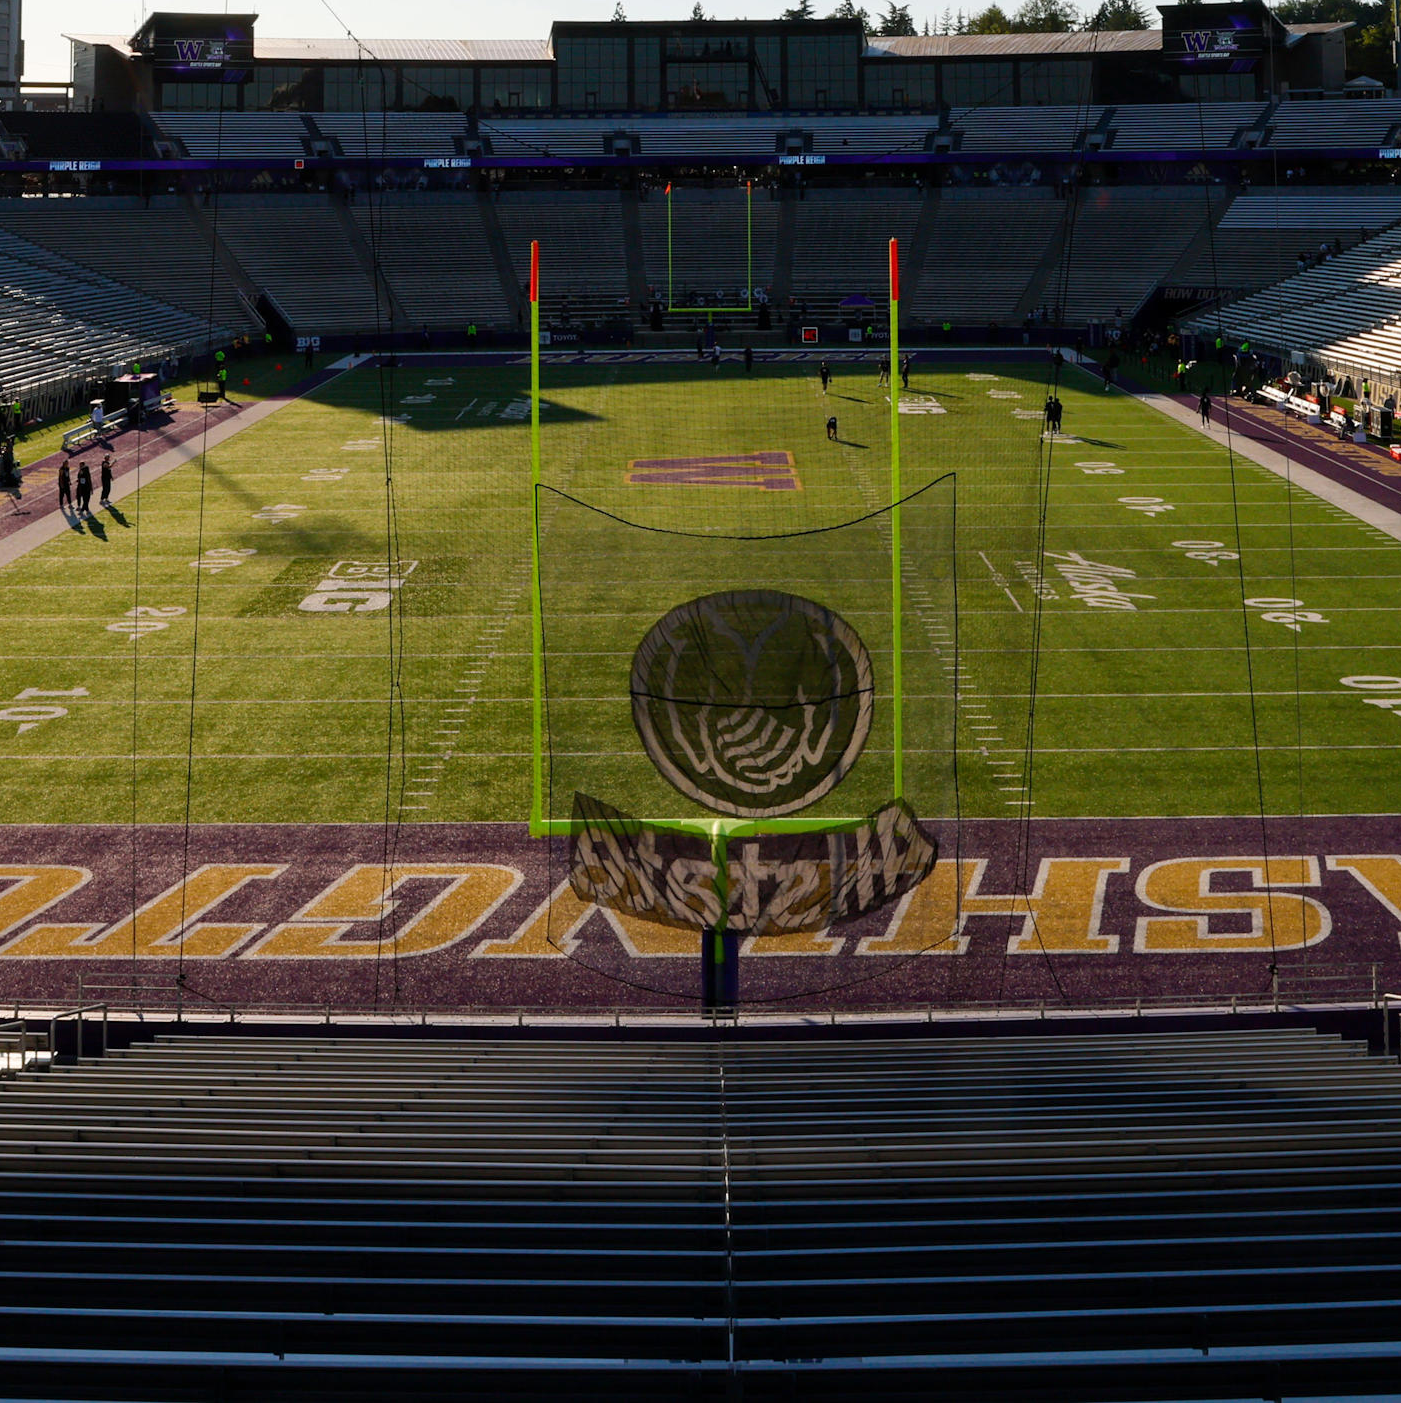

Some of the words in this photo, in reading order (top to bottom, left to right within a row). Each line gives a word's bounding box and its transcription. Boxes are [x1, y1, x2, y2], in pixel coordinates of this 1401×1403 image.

[174, 40, 204, 62] W
[1181, 31, 1211, 52] W
[300, 468, 350, 481] 50
[624, 450, 804, 491] W
[1073, 461, 1126, 475] 50
[252, 503, 308, 520] 40
[1117, 496, 1177, 513] 40
[188, 548, 258, 568] 30
[1170, 540, 1240, 561] 30
[106, 606, 188, 633] 20
[1244, 597, 1330, 624] 20
